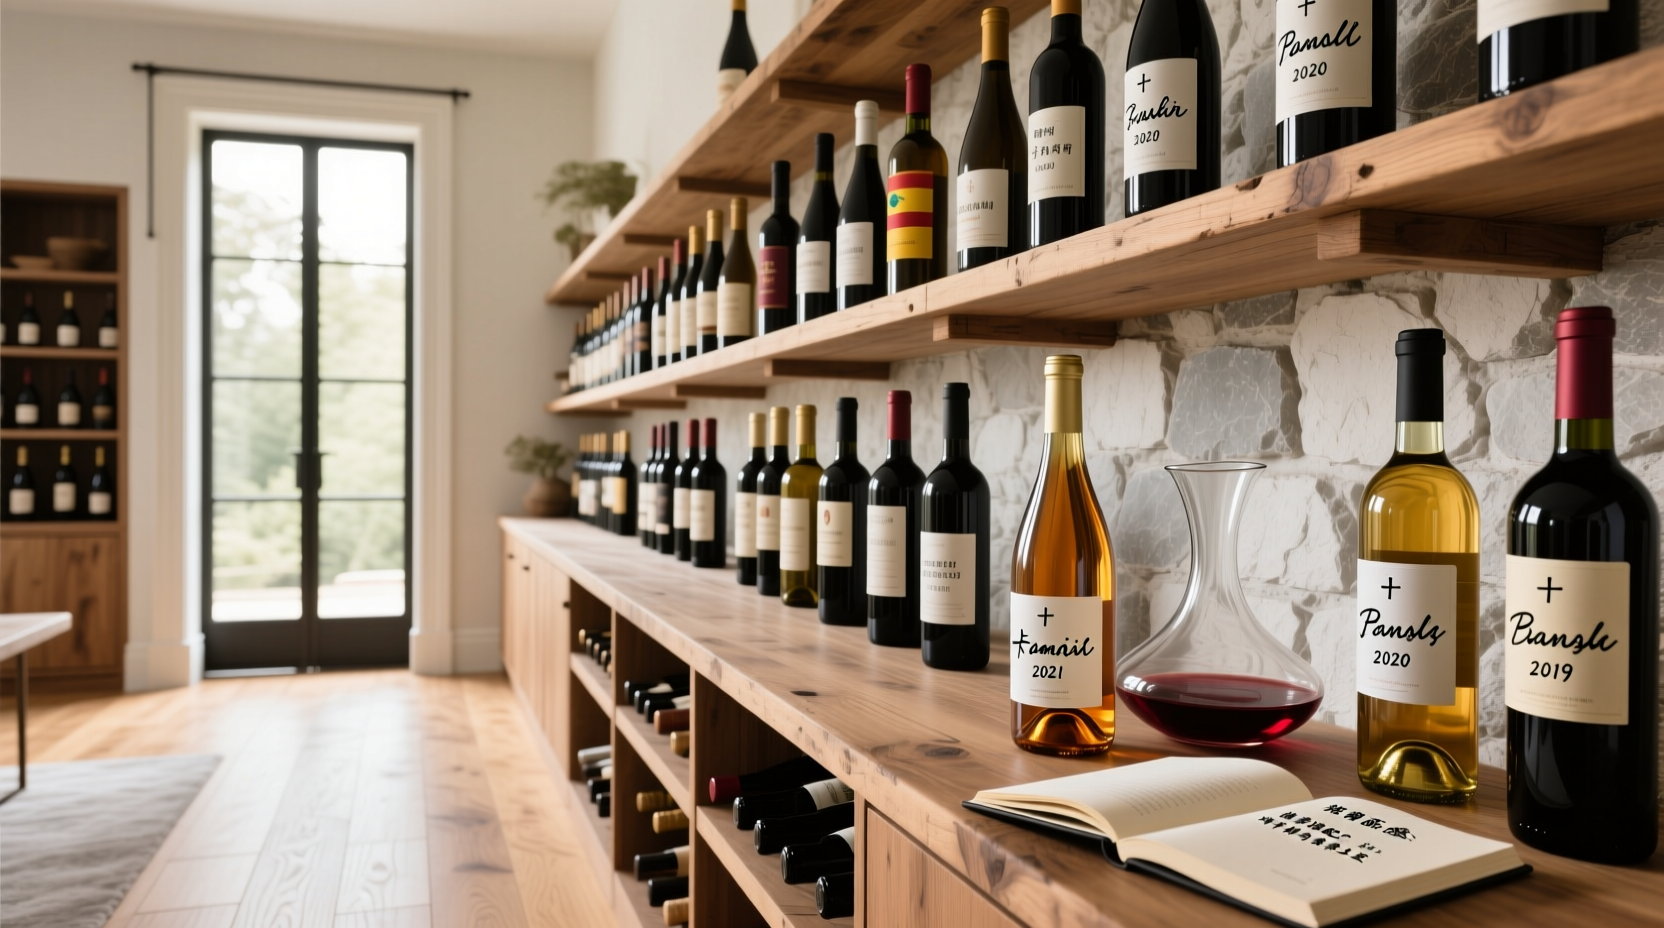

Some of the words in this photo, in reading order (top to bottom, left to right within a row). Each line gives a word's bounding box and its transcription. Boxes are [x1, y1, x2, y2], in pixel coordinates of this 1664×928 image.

[1292, 61, 1327, 82] 2020
[1133, 129, 1160, 146] 2020
[1373, 650, 1411, 668] 2020
[1032, 665, 1063, 679] 2021
[1529, 660, 1574, 683] 2019
